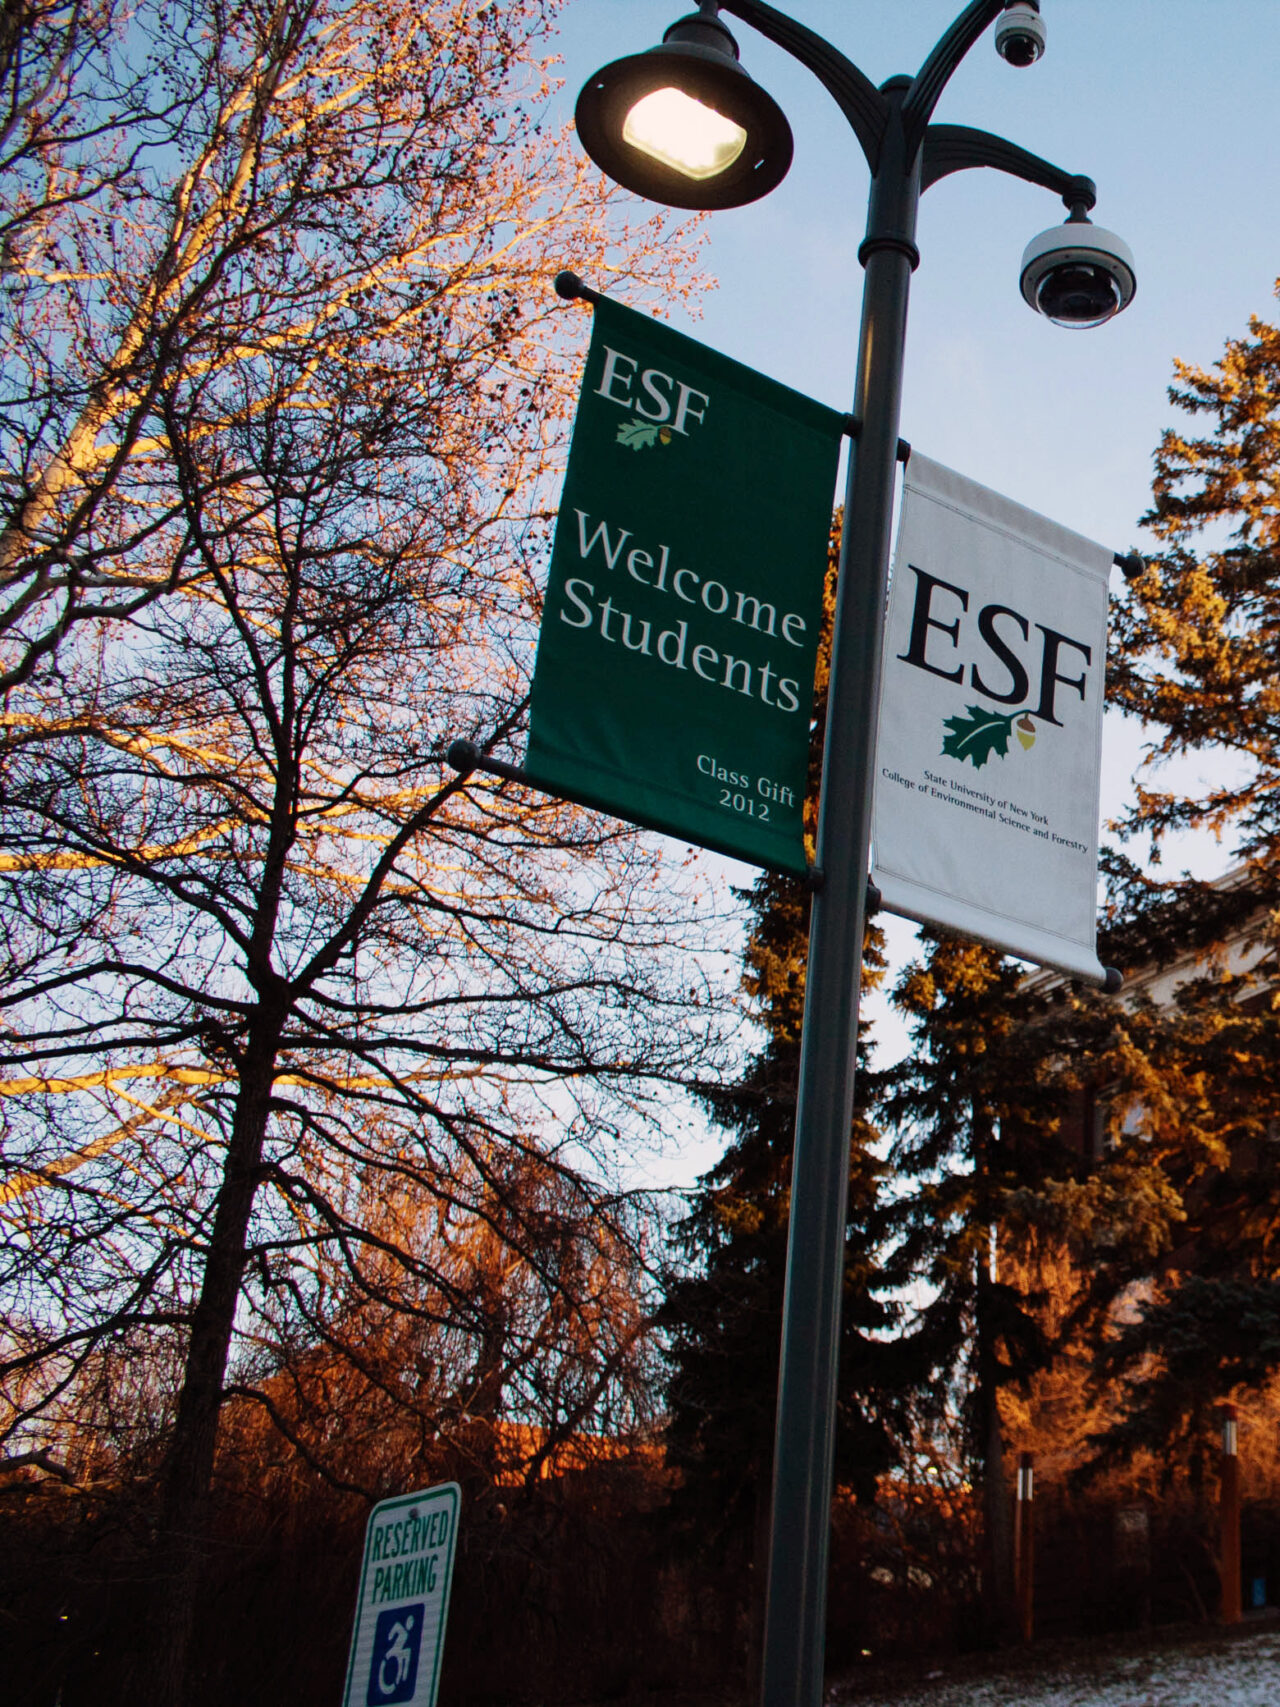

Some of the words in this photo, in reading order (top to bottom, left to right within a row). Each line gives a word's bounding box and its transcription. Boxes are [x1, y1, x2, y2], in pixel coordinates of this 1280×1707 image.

[594, 345, 710, 437] ESF
[573, 508, 807, 648] Welcome
[560, 578, 800, 713] Students
[896, 563, 1092, 728] ESF
[696, 754, 750, 789] Class
[757, 777, 796, 808] Gift
[718, 788, 771, 822] 2012
[882, 768, 916, 790] College
[918, 783, 929, 794] of
[930, 787, 996, 820] Environmental
[998, 813, 1032, 833] Science
[1032, 826, 1050, 840] and
[1051, 833, 1089, 854] Forestry
[923, 770, 948, 787] State
[950, 780, 996, 807] University
[997, 800, 1009, 809] of
[1009, 803, 1029, 817] New
[1030, 812, 1049, 826] York
[371, 1509, 449, 1562] RESERVED
[371, 1554, 439, 1605] PARKING
